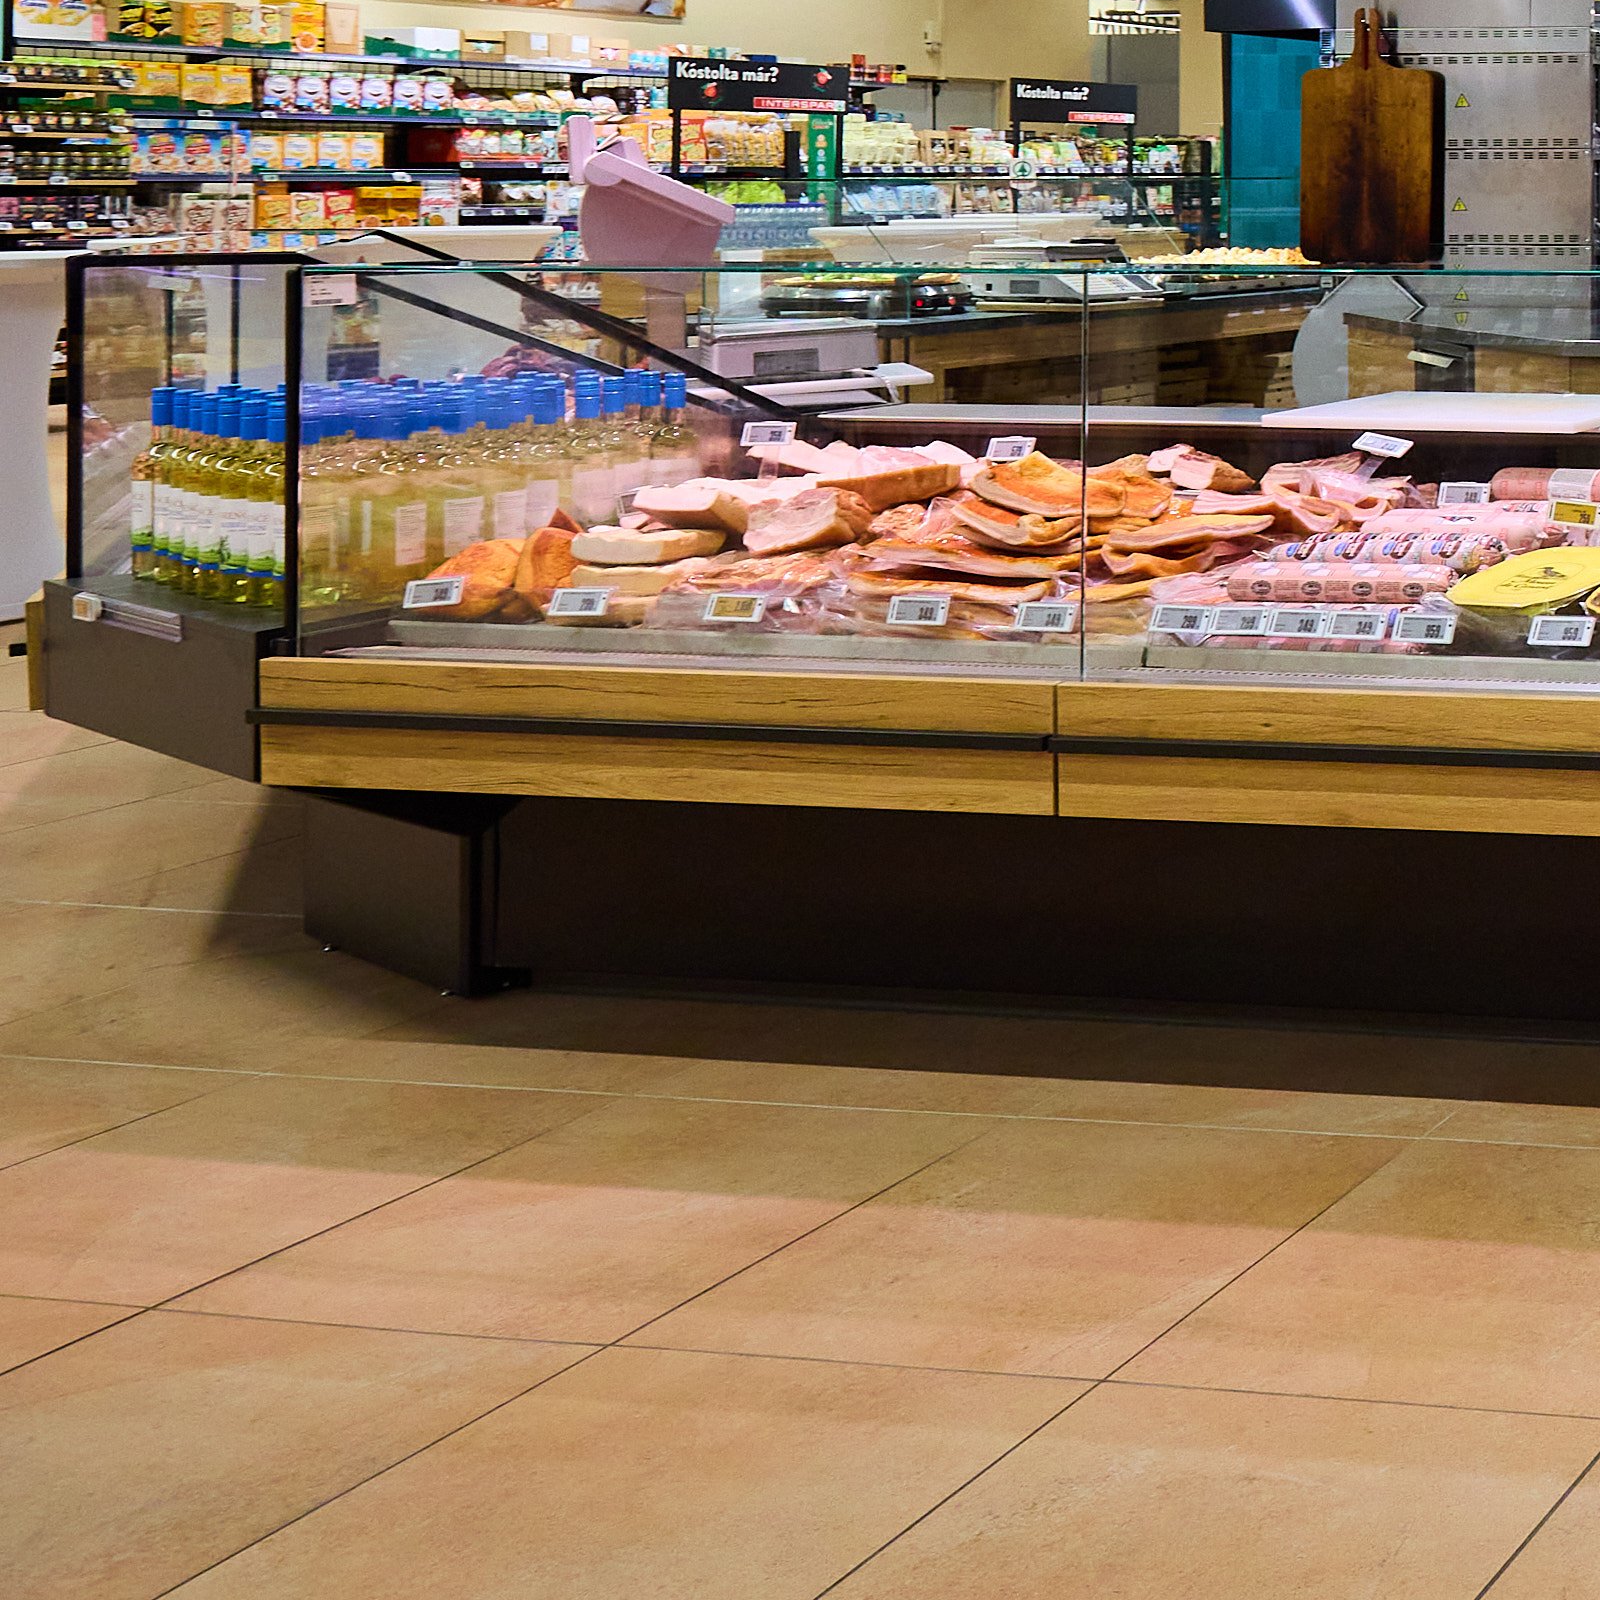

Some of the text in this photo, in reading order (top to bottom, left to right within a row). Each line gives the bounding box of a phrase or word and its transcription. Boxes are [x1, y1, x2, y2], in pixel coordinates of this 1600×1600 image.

[676, 61, 779, 84] Kóstolta már?
[1016, 83, 1090, 101] Kóstolta már?
[761, 99, 834, 110] INTERSPAR
[1074, 113, 1126, 122] INTERSPAR
